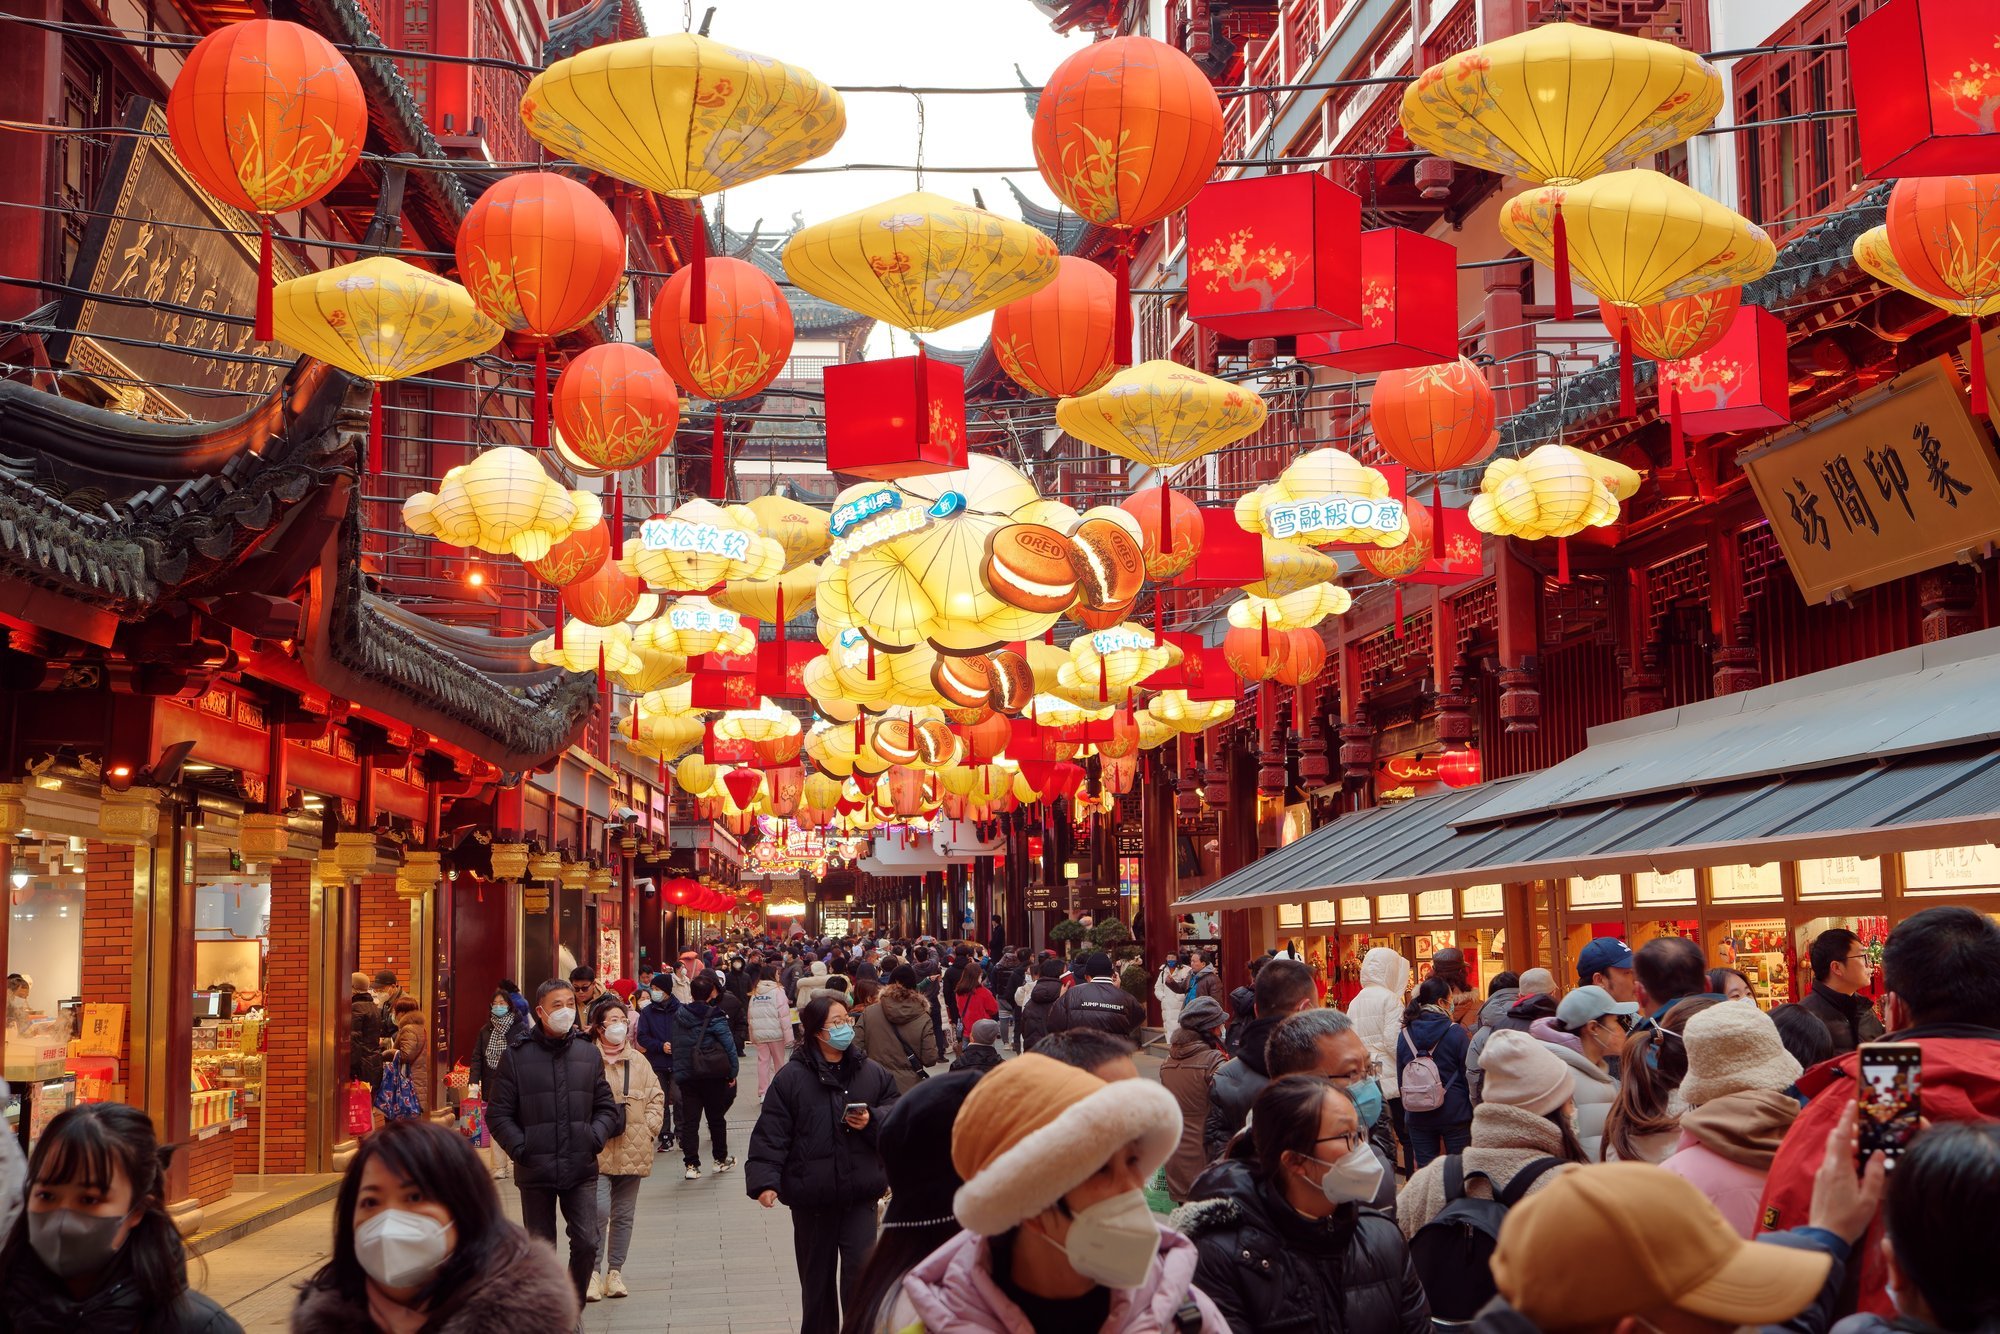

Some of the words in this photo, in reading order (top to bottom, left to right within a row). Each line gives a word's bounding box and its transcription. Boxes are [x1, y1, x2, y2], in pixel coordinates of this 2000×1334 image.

[833, 491, 893, 532] 奥利奥
[1273, 502, 1400, 535] 雪融般口感
[644, 523, 746, 558] 松松软软
[1020, 534, 1061, 557] OREO
[1112, 535, 1135, 572] OREO
[671, 610, 734, 632] 软奥奥
